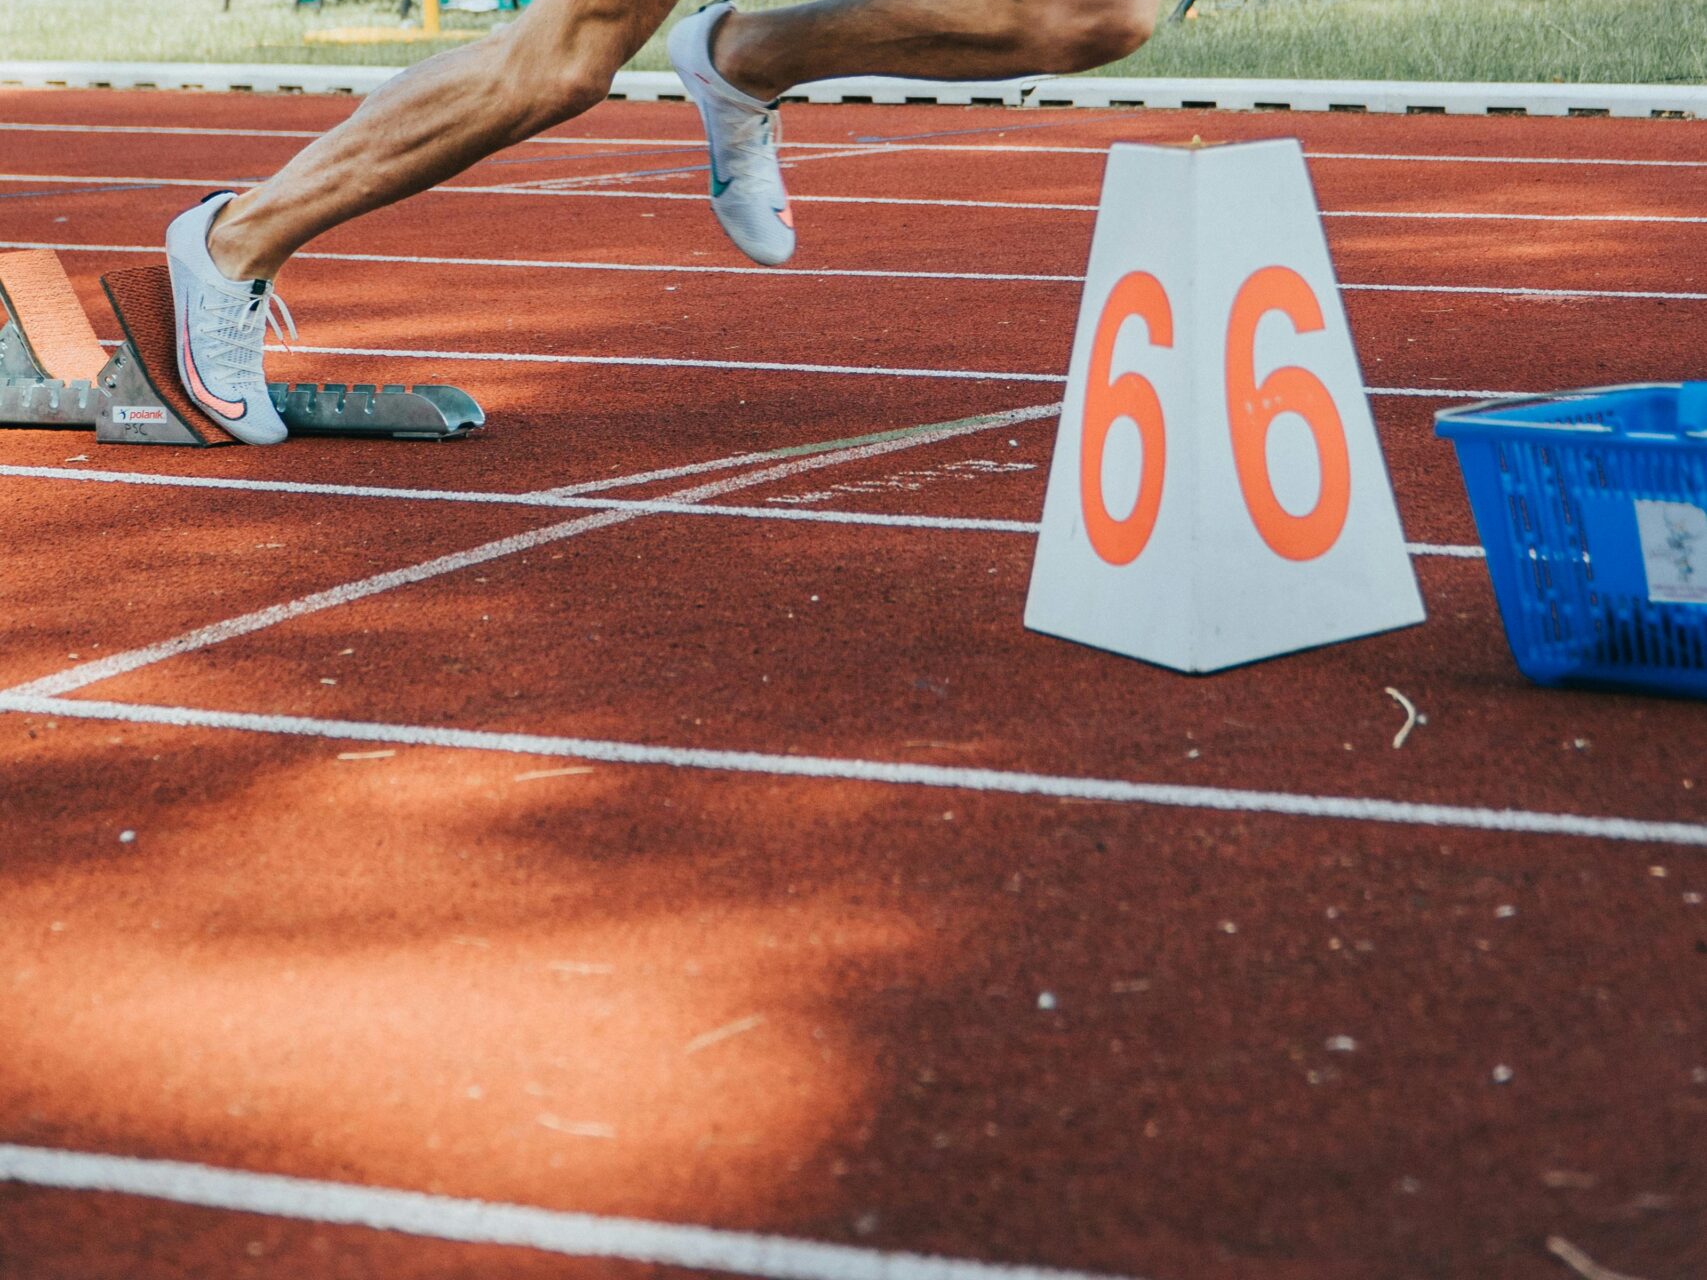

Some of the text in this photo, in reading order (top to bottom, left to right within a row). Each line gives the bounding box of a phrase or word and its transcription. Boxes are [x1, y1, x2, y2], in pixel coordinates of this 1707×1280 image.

[129, 410, 163, 420] polanik
[1081, 271, 1173, 565] 6
[1225, 265, 1351, 562] 6
